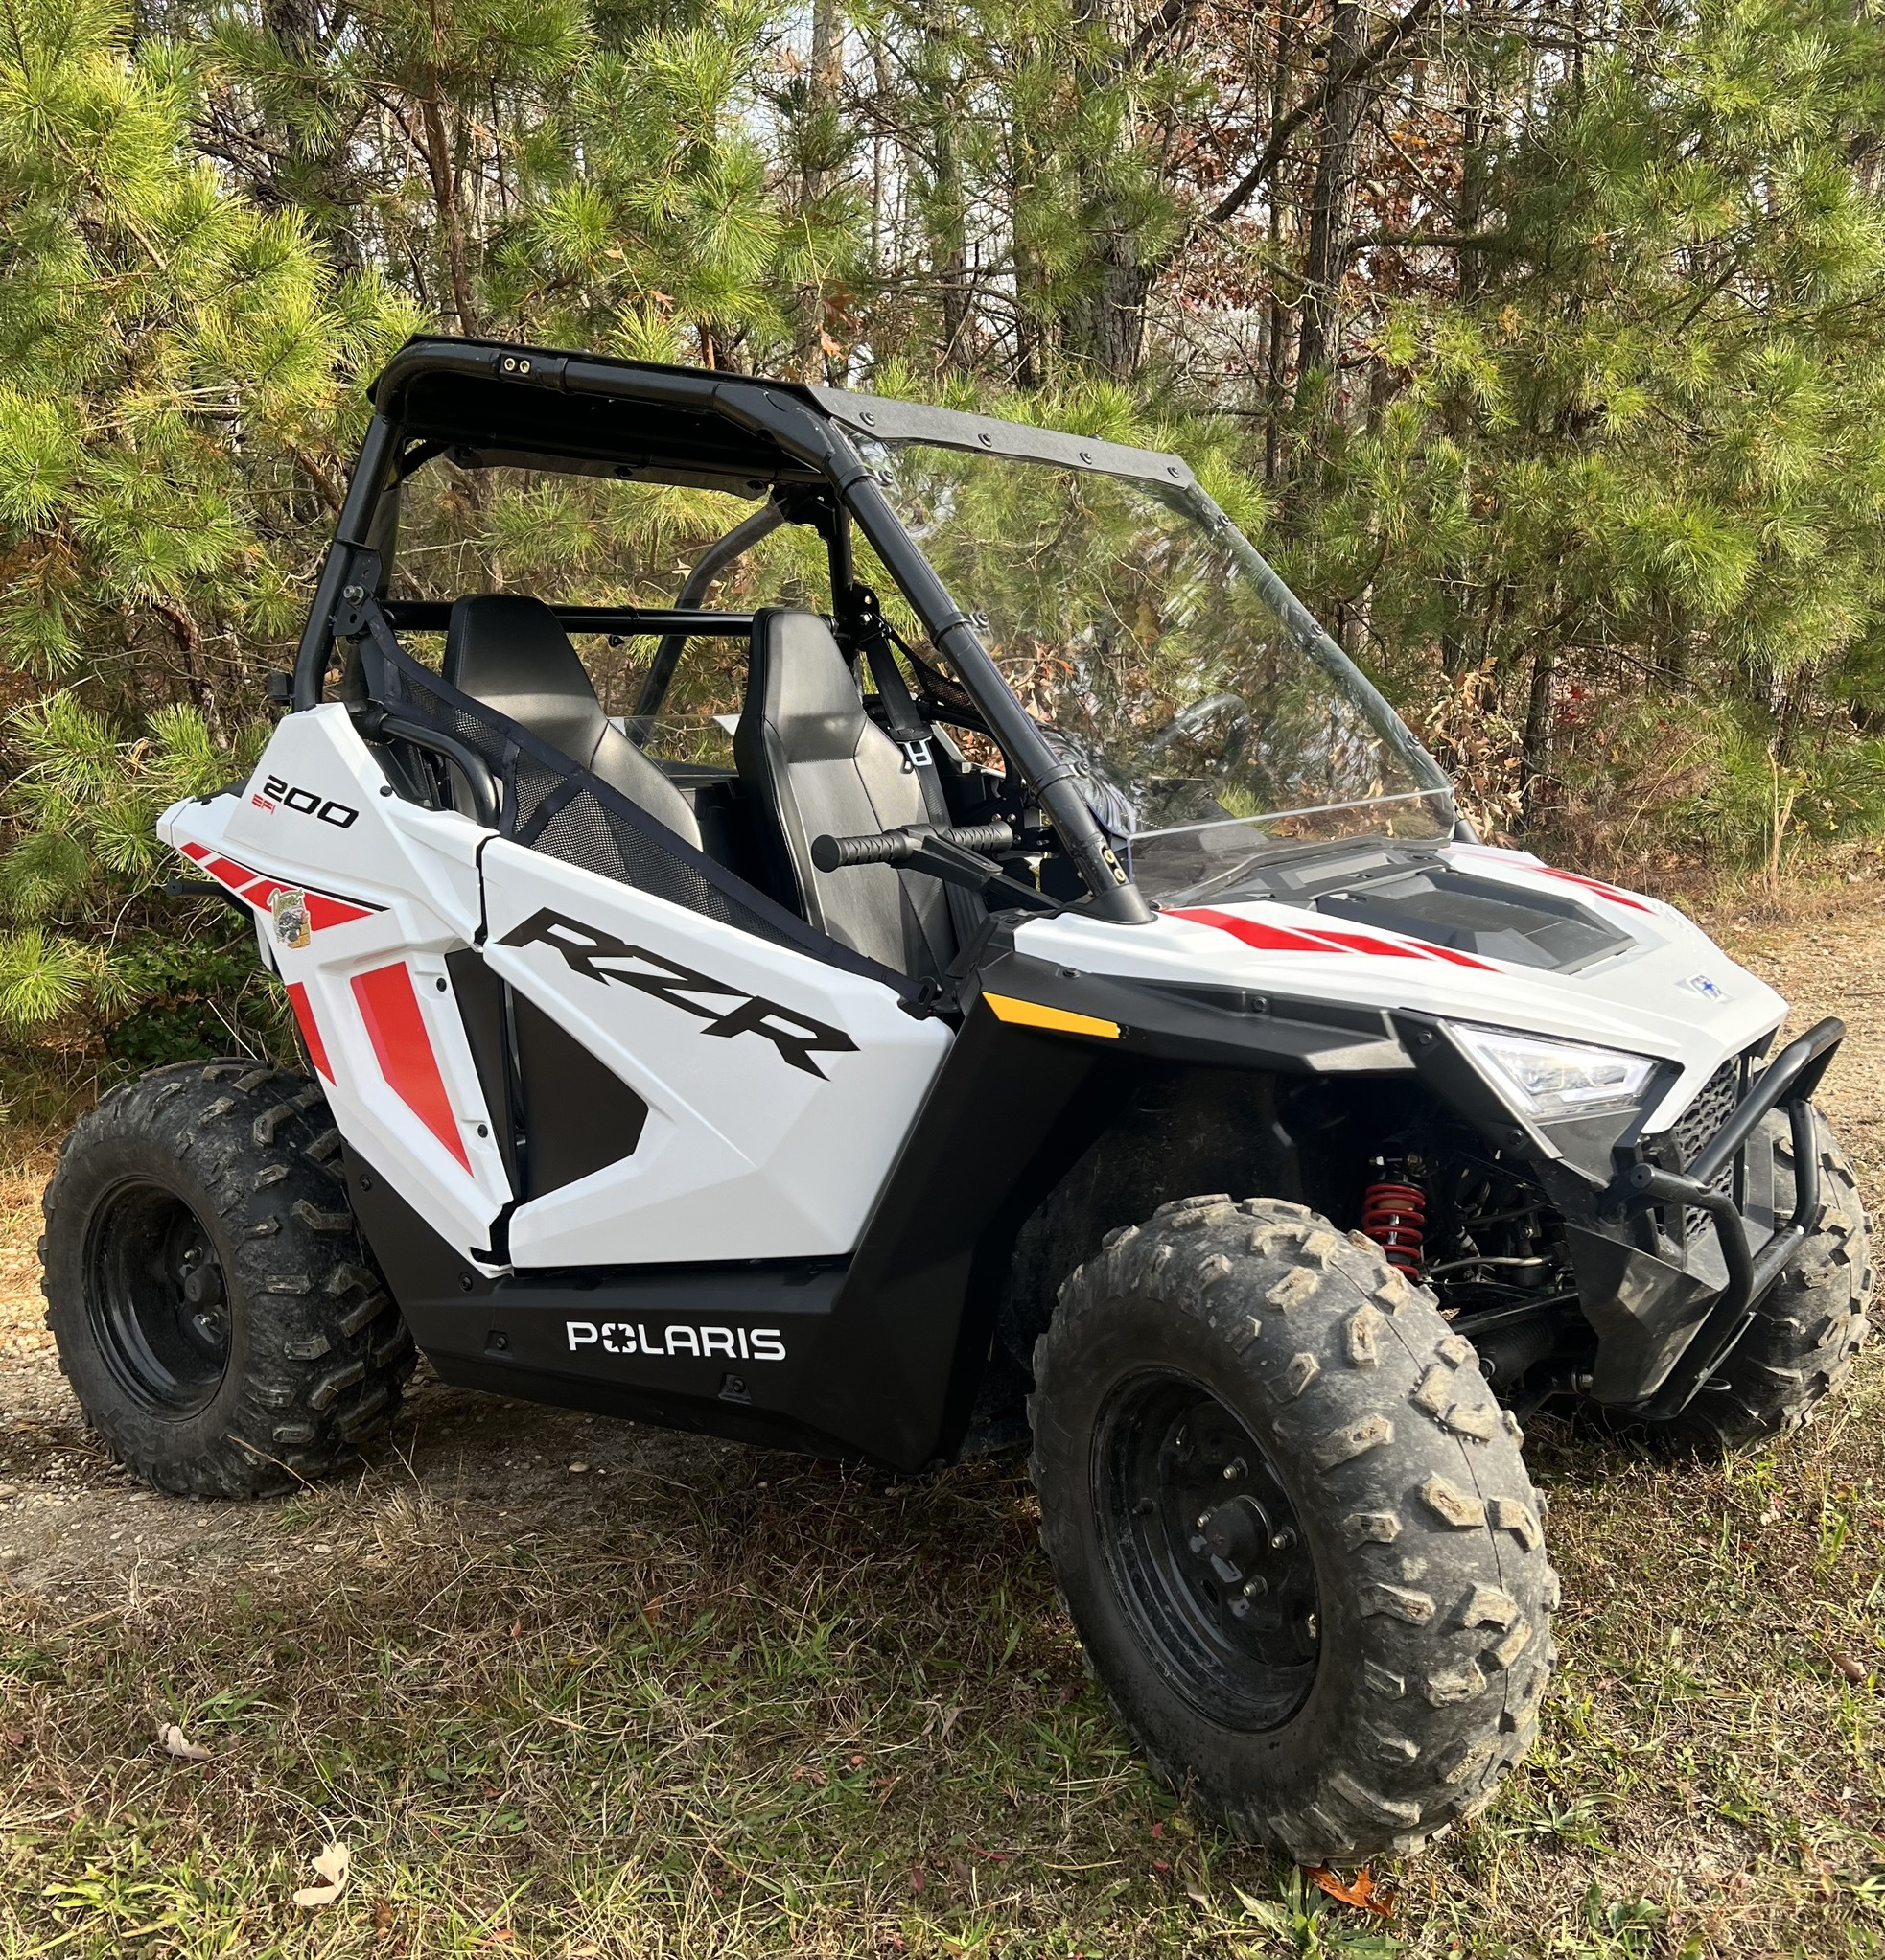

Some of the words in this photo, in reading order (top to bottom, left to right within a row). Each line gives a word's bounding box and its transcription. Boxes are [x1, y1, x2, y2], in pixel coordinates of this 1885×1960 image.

[251, 794, 276, 815] EFI
[263, 774, 359, 829] 200
[494, 907, 861, 1082] RZR
[566, 1321, 786, 1361] POLARIS
